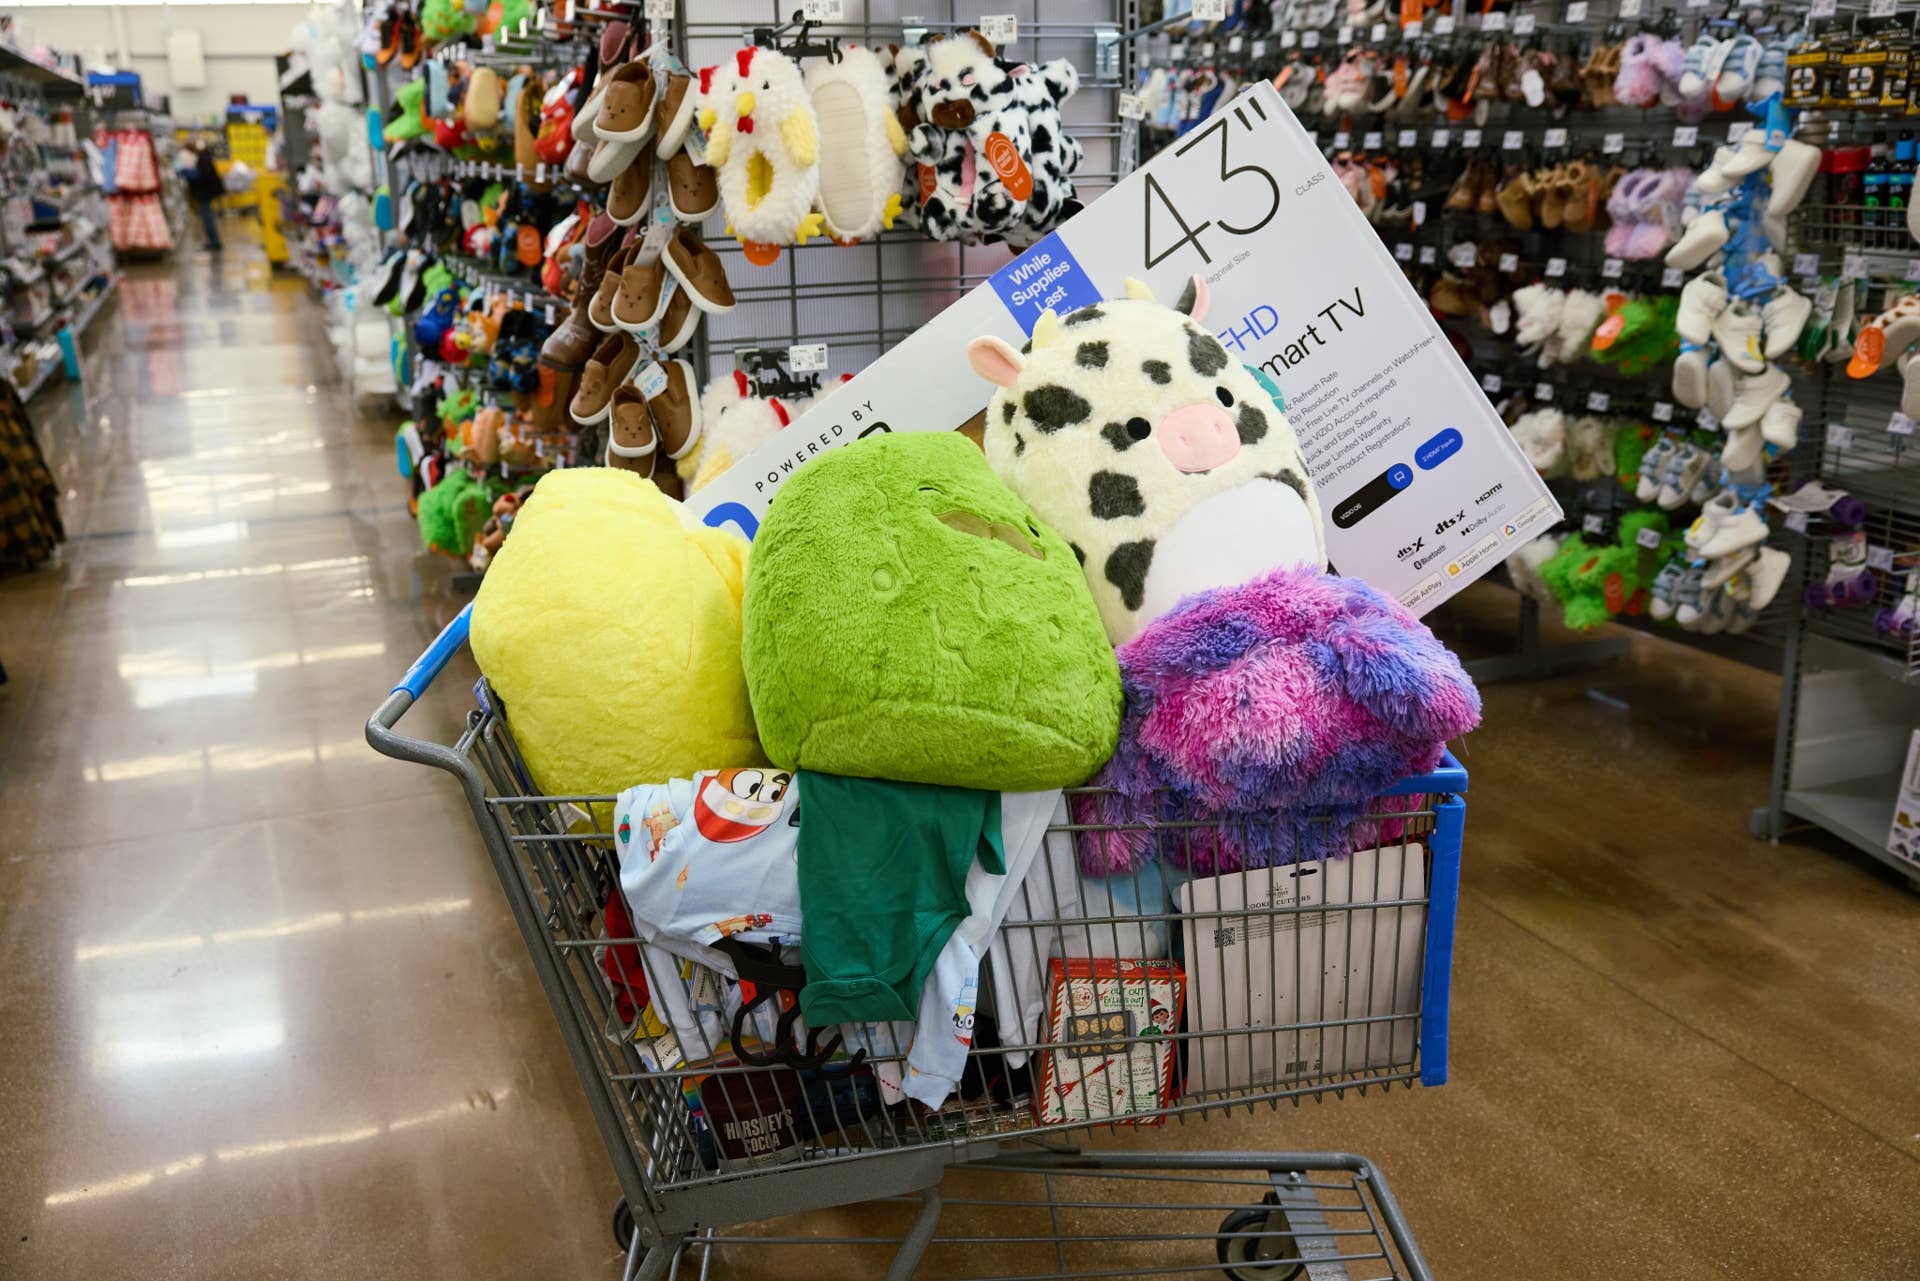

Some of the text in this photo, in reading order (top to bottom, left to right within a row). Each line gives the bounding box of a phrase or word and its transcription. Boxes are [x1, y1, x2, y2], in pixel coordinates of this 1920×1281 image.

[1145, 96, 1280, 270] 43"
[1295, 171, 1326, 196] CLASS
[1009, 253, 1051, 285] While
[1233, 250, 1251, 264] Size
[1011, 261, 1070, 307] Supplies
[1034, 285, 1068, 314] Last
[1258, 287, 1364, 376] mart TV
[1292, 383, 1320, 405] Refresh
[1320, 371, 1338, 385] Rate
[1305, 415, 1323, 429] Free
[1323, 404, 1339, 417] Live
[1337, 394, 1350, 405] TV
[1350, 374, 1383, 398] channels
[1383, 366, 1393, 375] on
[1392, 336, 1435, 367] WatchFree+
[1301, 387, 1340, 416] Resolution
[1312, 423, 1334, 440] VIZIO
[1334, 402, 1365, 426] Account
[1364, 379, 1397, 405] required)
[1324, 436, 1338, 450] and
[1336, 426, 1356, 441] Easy
[1354, 410, 1378, 428] Setup
[755, 425, 843, 493] POWERED
[852, 401, 873, 421] BY
[1310, 416, 1392, 477] 2-Year Limited Warranty
[1317, 471, 1338, 488] (With
[1336, 450, 1367, 474] Product
[1475, 483, 1502, 505] HDMI
[1434, 517, 1456, 535] dts
[1469, 517, 1488, 531] Dolby
[1487, 503, 1506, 518] Audio
[1420, 544, 1447, 566] Bluetooth
[1461, 552, 1480, 569] Apple
[1479, 540, 1499, 558] Home
[1419, 580, 1442, 598] AirPlay
[1276, 896, 1311, 905] CUTTRS
